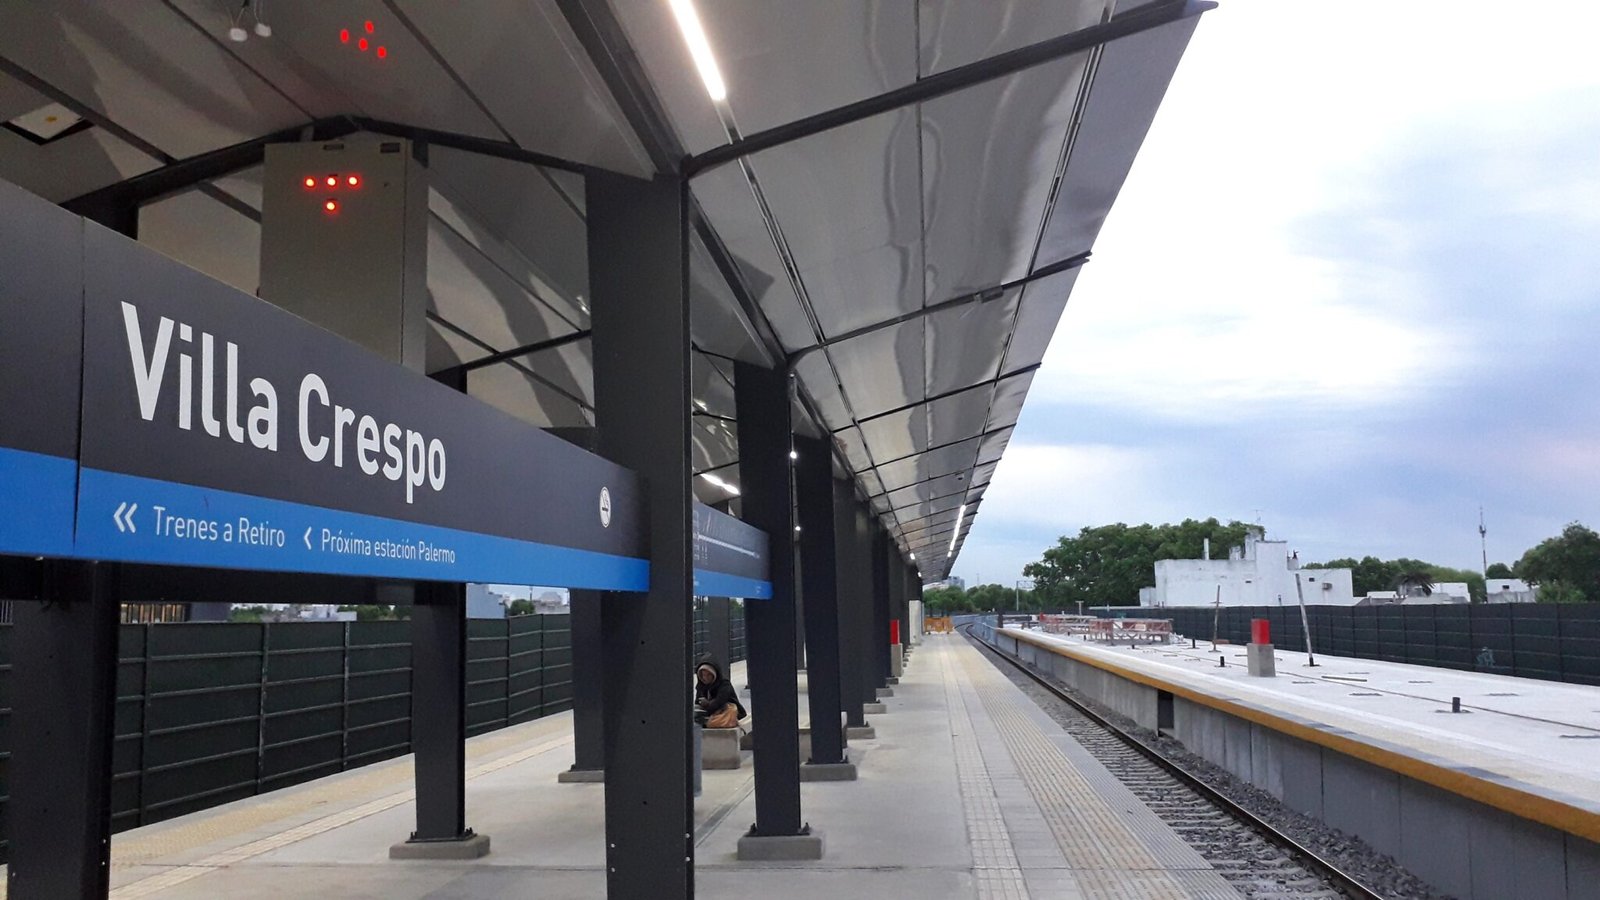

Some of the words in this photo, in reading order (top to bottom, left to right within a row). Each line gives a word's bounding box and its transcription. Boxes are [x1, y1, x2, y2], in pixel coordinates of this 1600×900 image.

[121, 300, 278, 452] Villa
[298, 372, 447, 504] Crespo
[153, 505, 218, 541] Trenes
[223, 522, 233, 542] a
[238, 517, 285, 547] Retiro
[321, 528, 371, 556] Próxima
[374, 538, 416, 560] estación
[418, 540, 456, 564] Palermo
